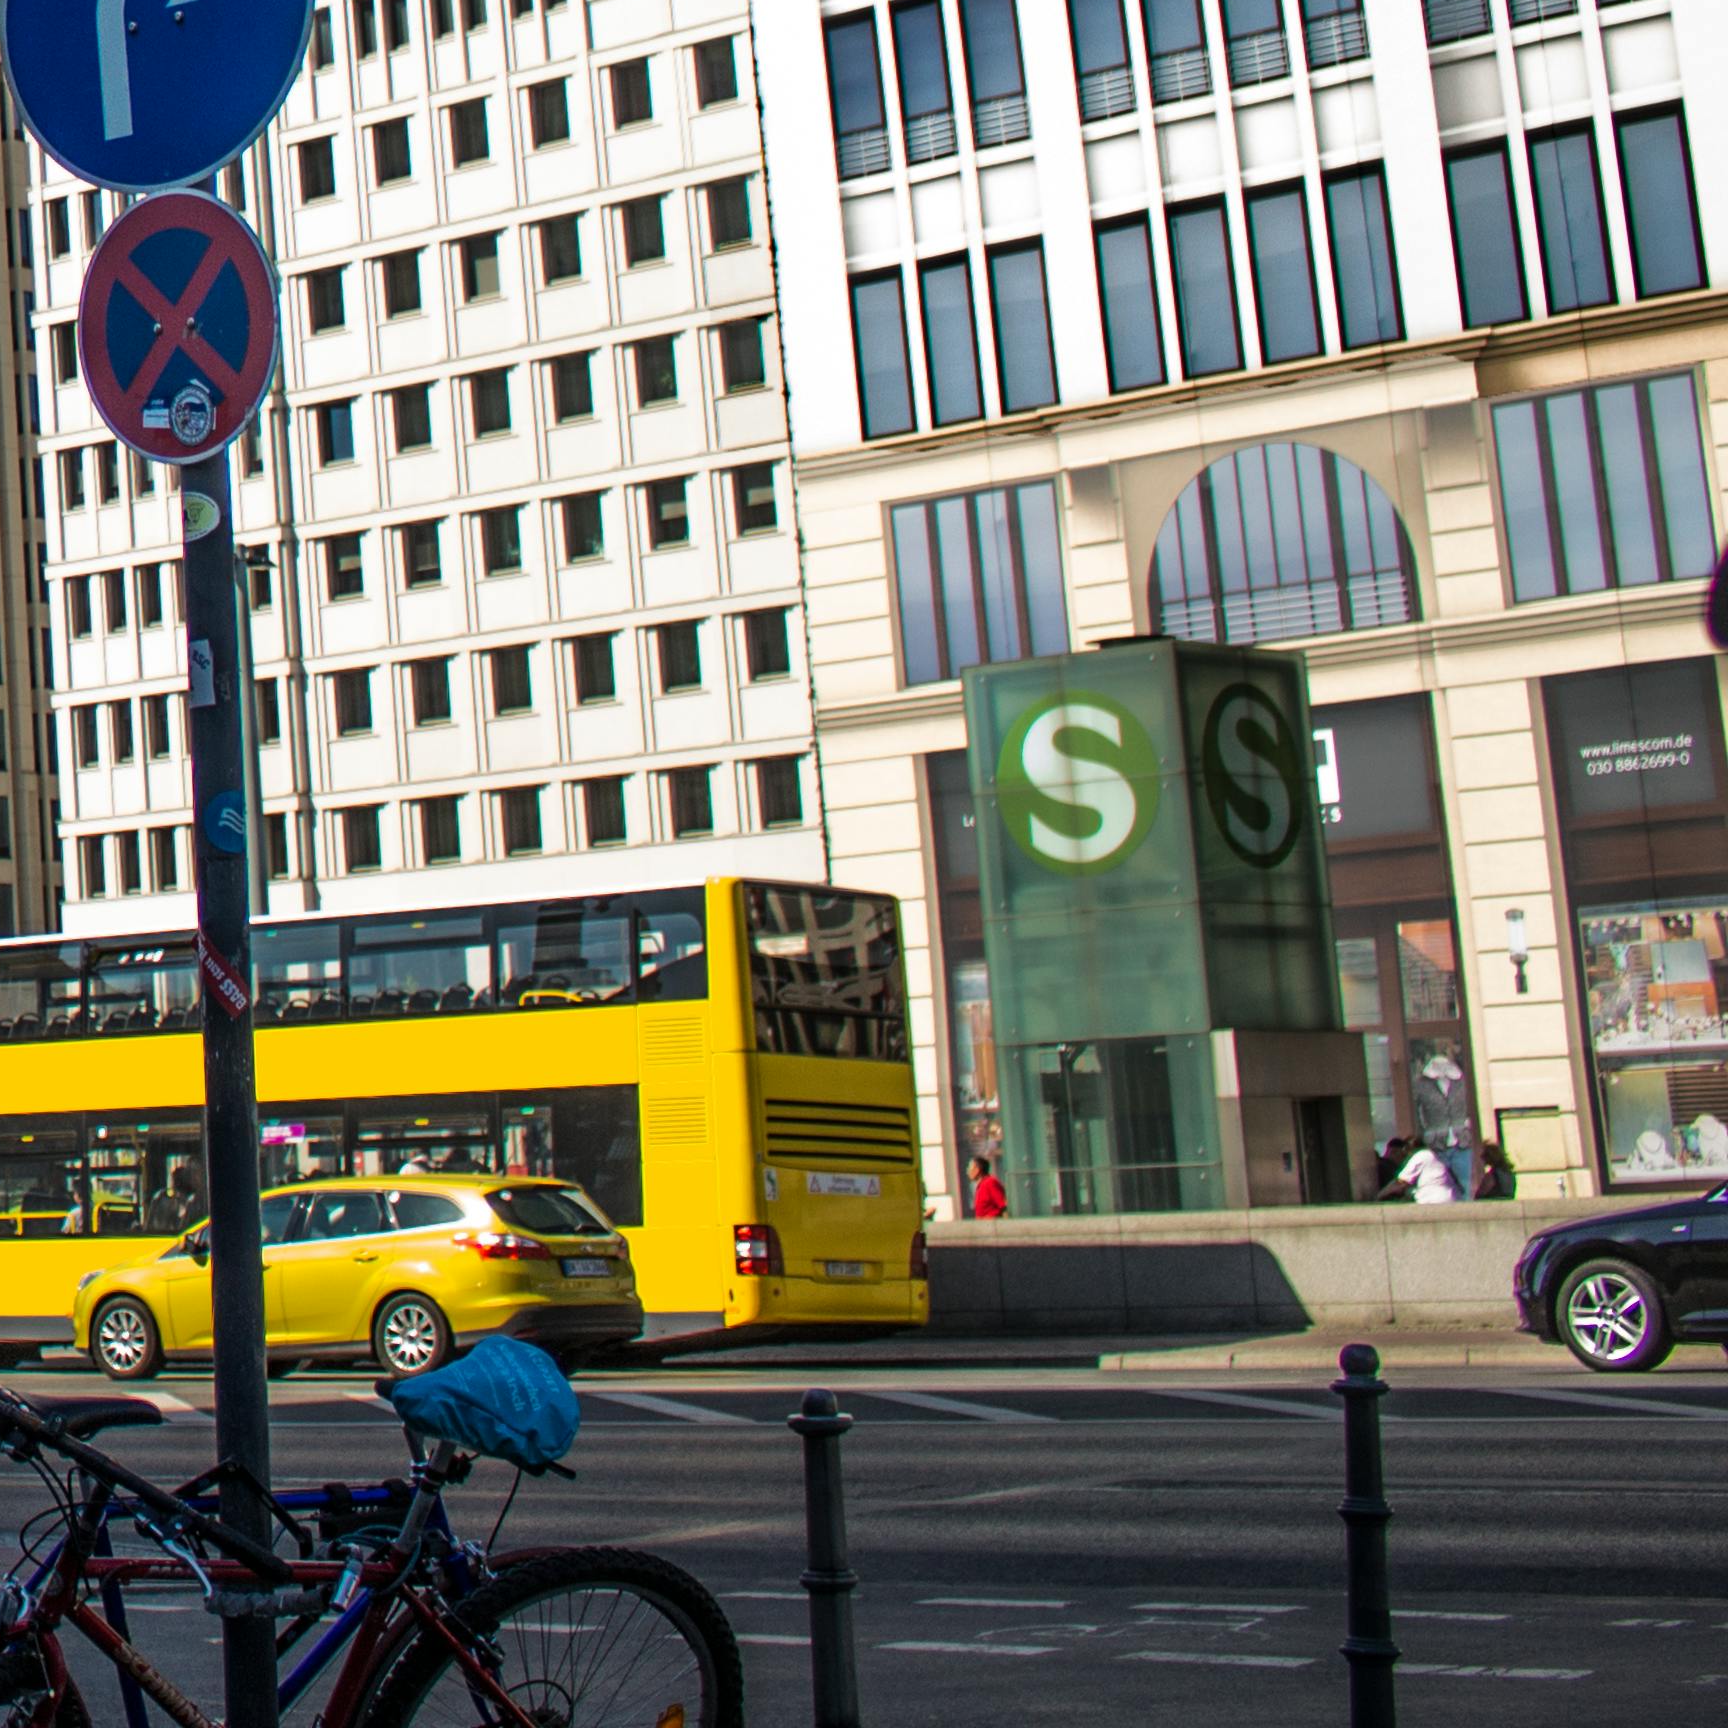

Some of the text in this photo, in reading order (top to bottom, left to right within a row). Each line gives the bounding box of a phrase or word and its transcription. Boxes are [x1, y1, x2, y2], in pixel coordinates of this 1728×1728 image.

[1021, 702, 1137, 864] S
[1216, 696, 1292, 856] S
[1580, 733, 1693, 759] www.limescom.de
[1585, 758, 1613, 776] 030
